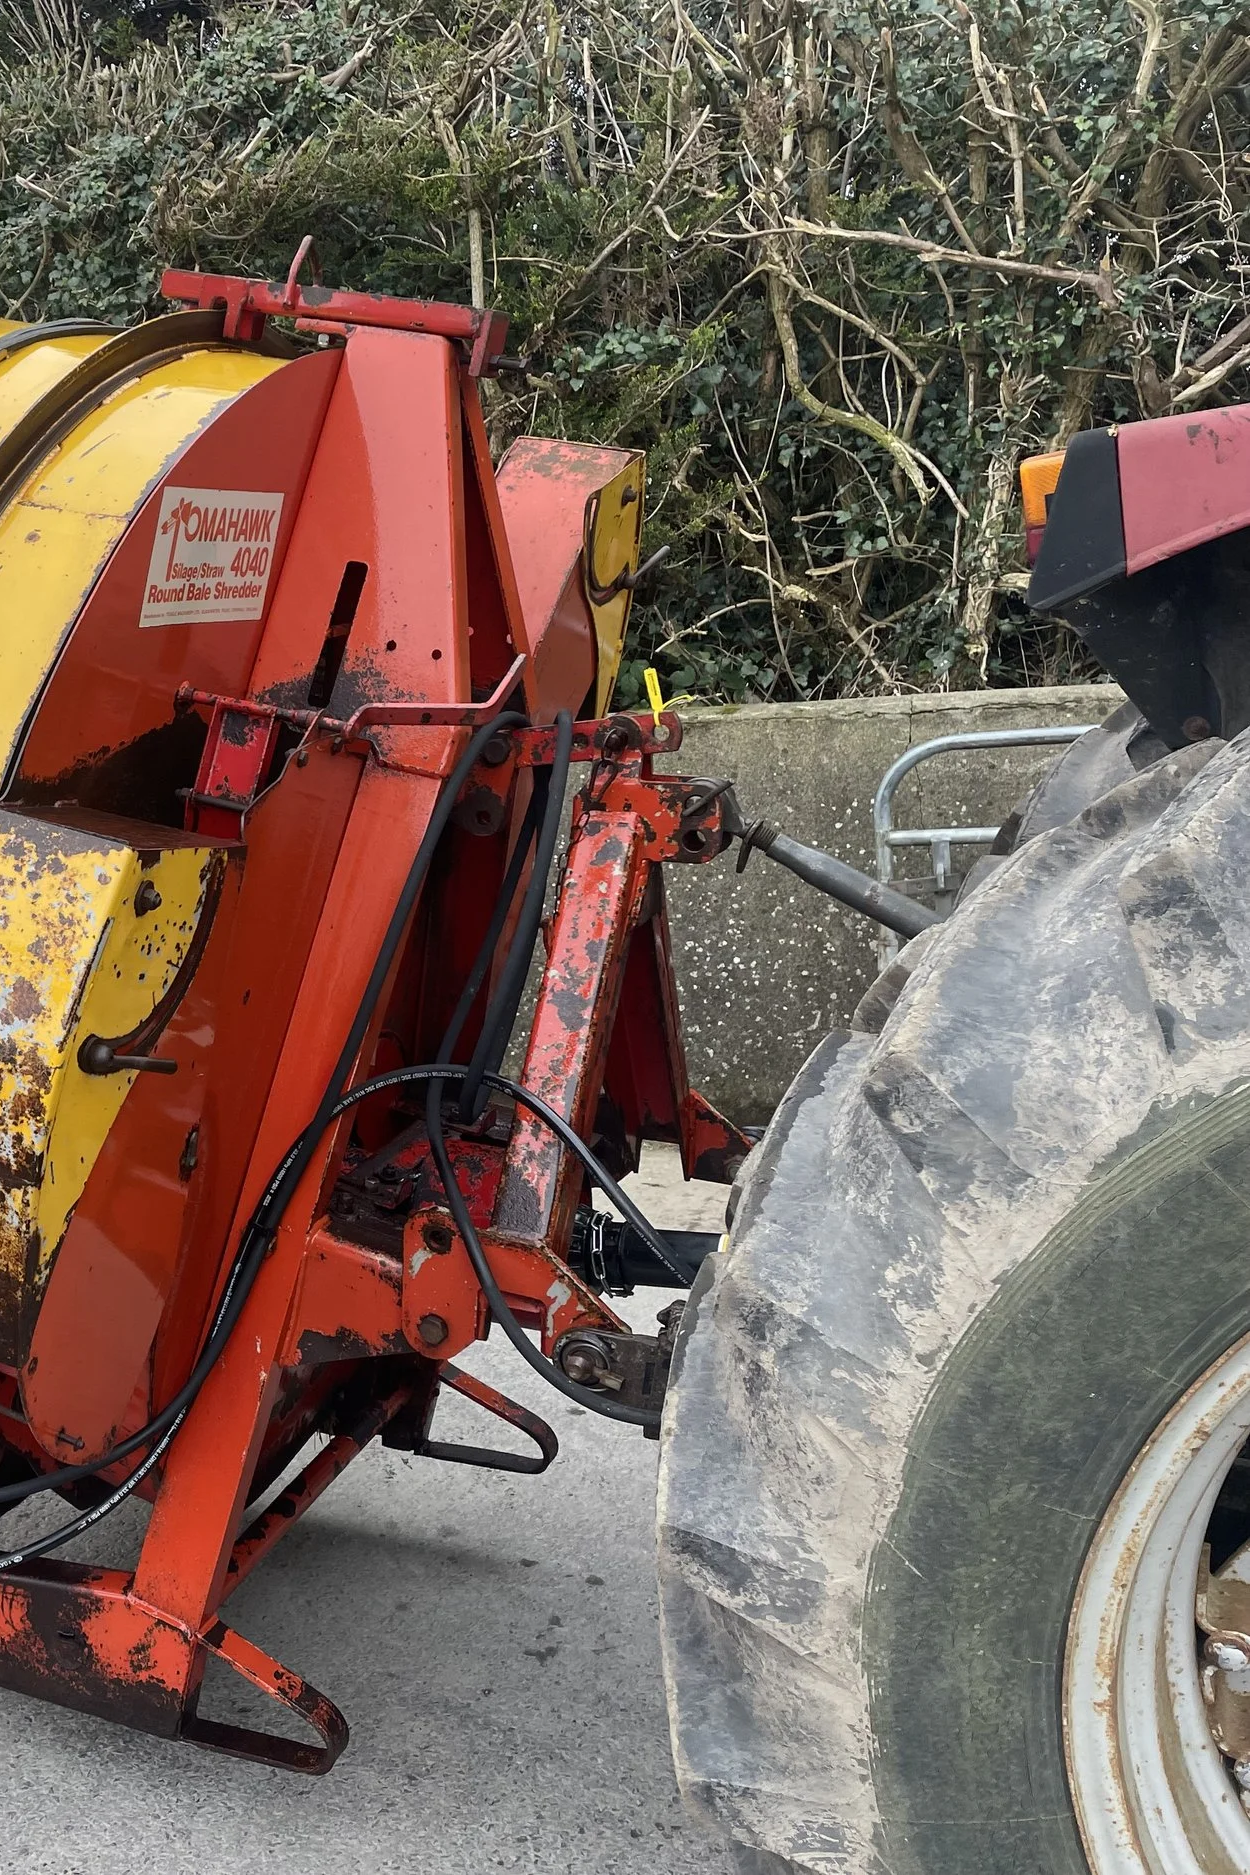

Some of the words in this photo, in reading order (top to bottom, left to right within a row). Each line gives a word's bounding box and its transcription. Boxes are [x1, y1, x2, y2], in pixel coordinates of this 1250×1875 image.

[172, 563, 225, 582] Silage/Straw
[230, 547, 269, 577] 4040
[148, 584, 186, 603] Round
[186, 583, 211, 601] Bale
[214, 581, 262, 599] Shredder
